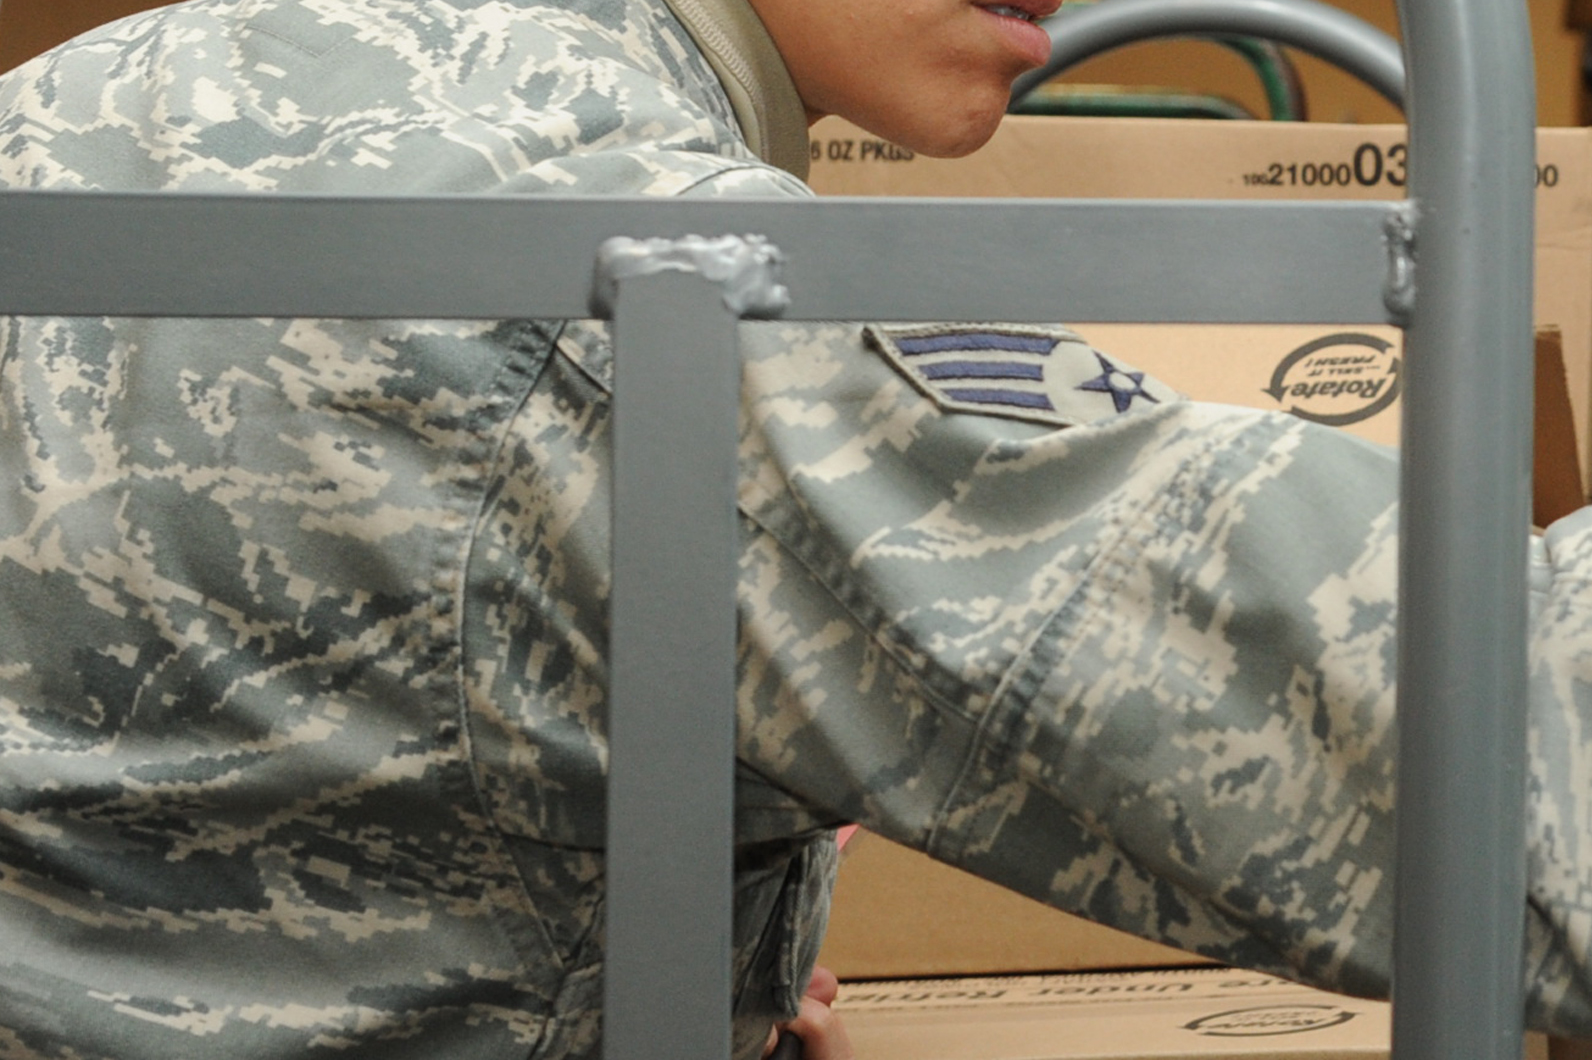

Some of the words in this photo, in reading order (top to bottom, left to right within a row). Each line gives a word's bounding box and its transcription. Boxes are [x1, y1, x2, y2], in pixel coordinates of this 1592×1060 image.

[827, 139, 854, 162] OZ
[1352, 142, 1409, 187] 03
[1290, 378, 1388, 399] Rotate
